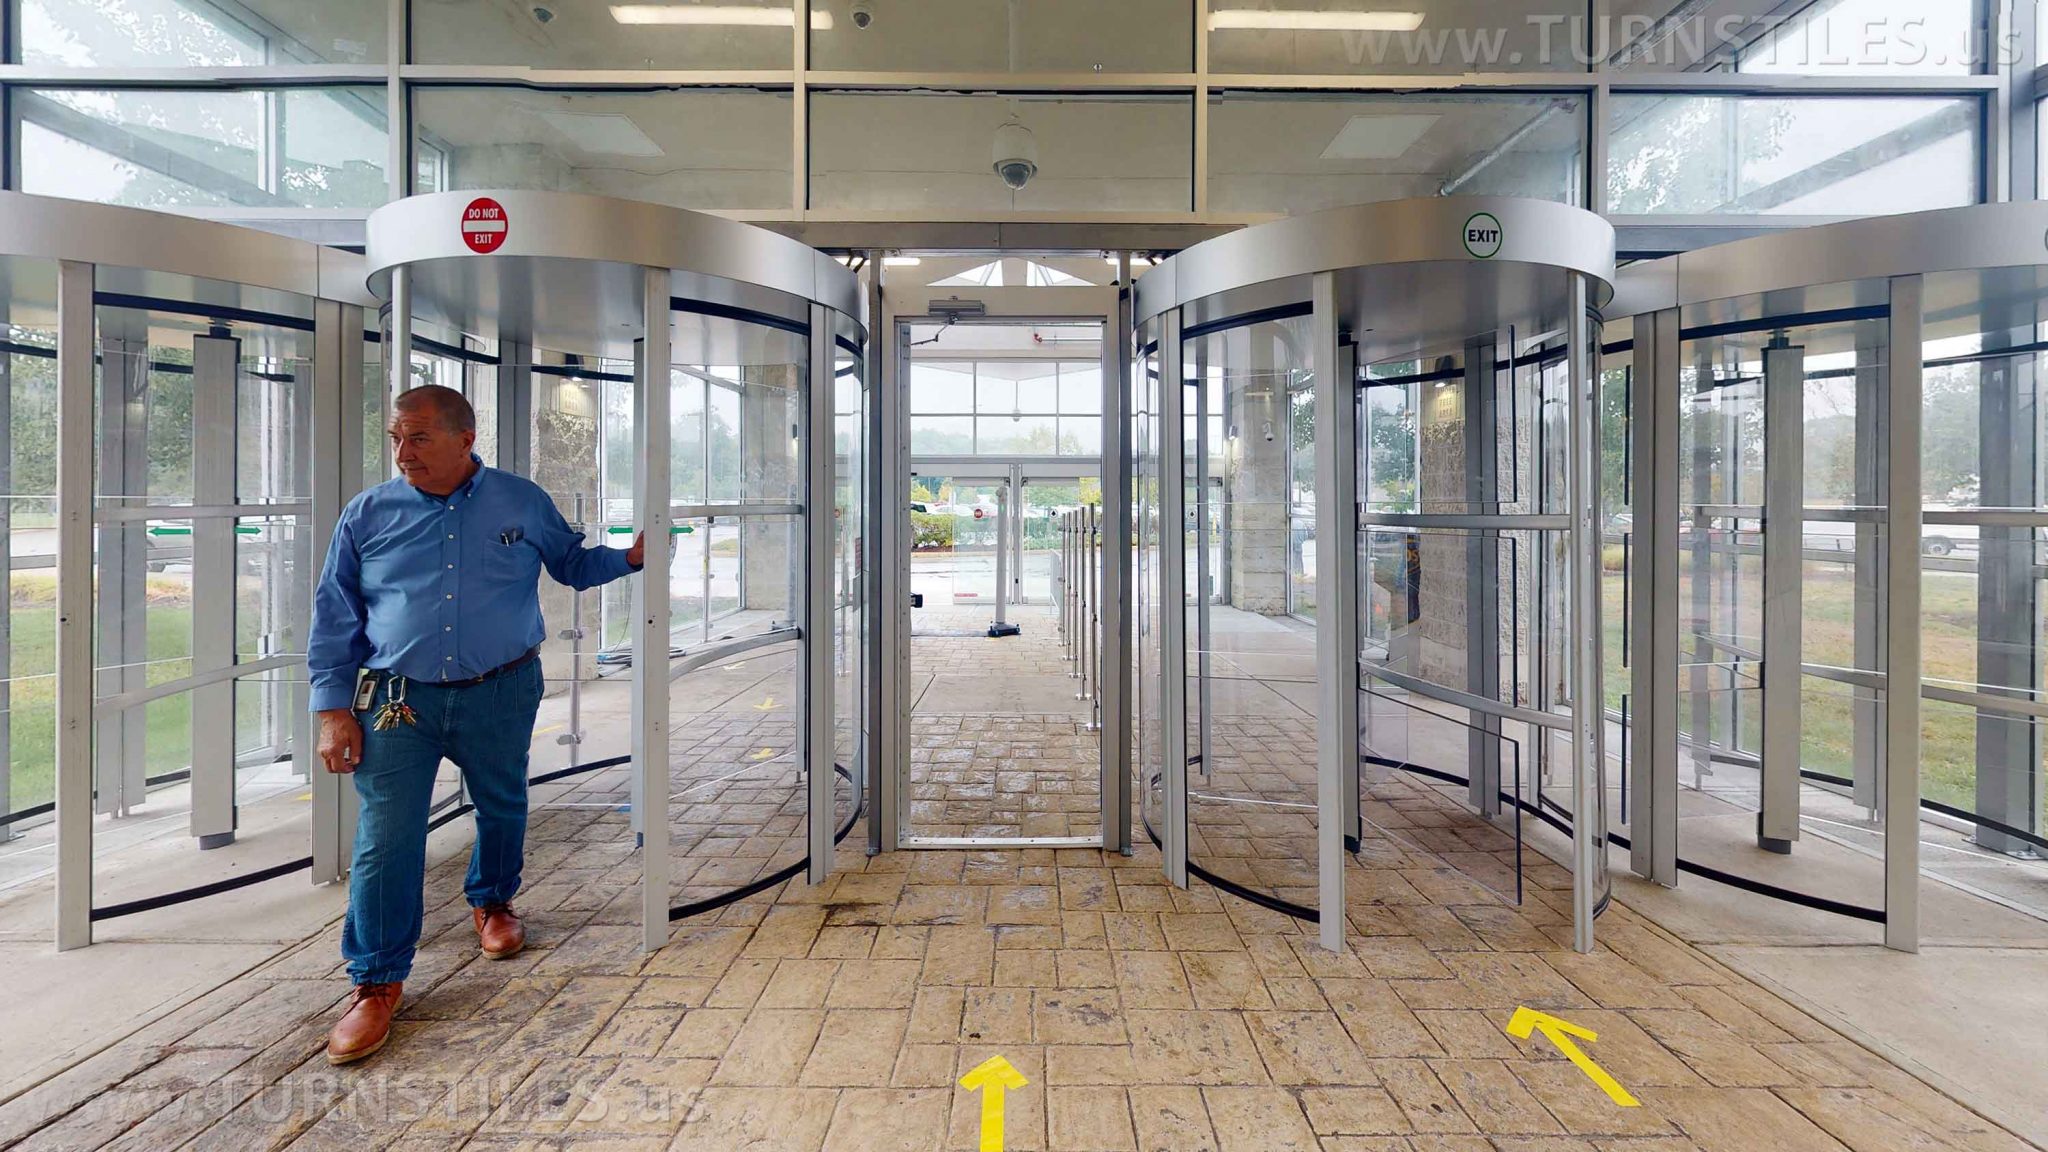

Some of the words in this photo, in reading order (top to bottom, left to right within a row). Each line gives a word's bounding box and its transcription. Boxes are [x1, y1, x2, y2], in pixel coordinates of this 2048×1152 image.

[469, 208, 481, 219] DO
[482, 208, 499, 219] NOT
[474, 234, 493, 244] EXIT
[1468, 229, 1499, 243] EXIT
